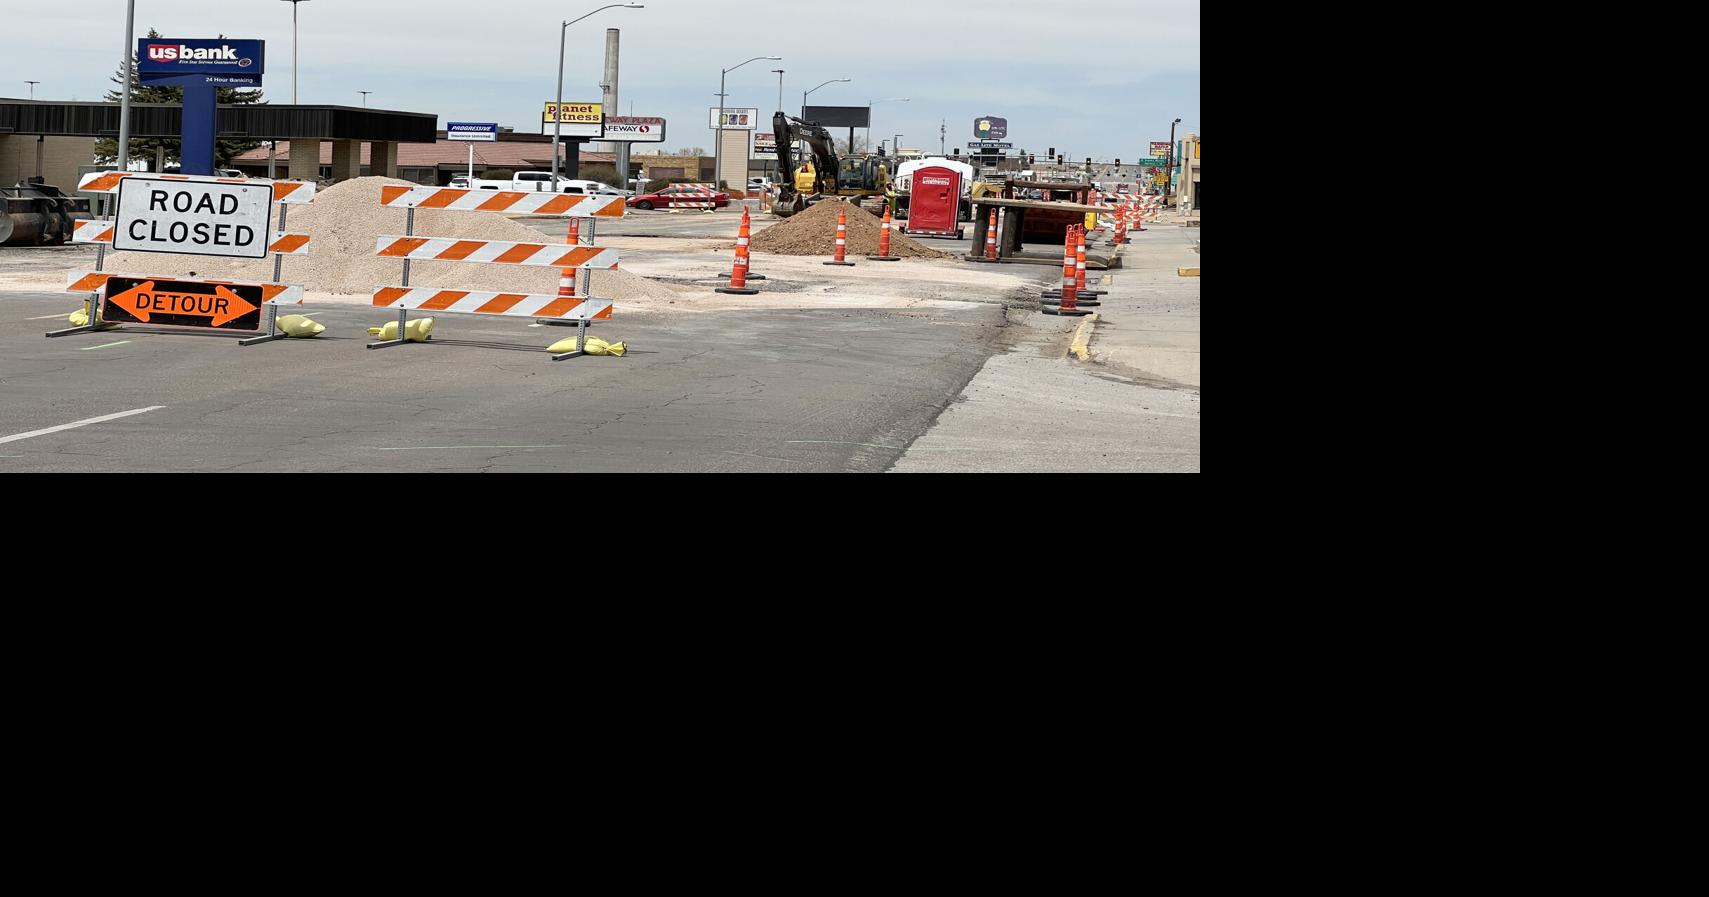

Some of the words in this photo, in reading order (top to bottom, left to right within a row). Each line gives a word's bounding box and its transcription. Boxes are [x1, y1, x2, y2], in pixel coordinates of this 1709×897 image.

[547, 105, 593, 114] panet
[552, 112, 600, 121] ftness
[150, 189, 239, 215] ROAD
[128, 219, 254, 247] CLOSED
[136, 292, 229, 315] DETOUR
